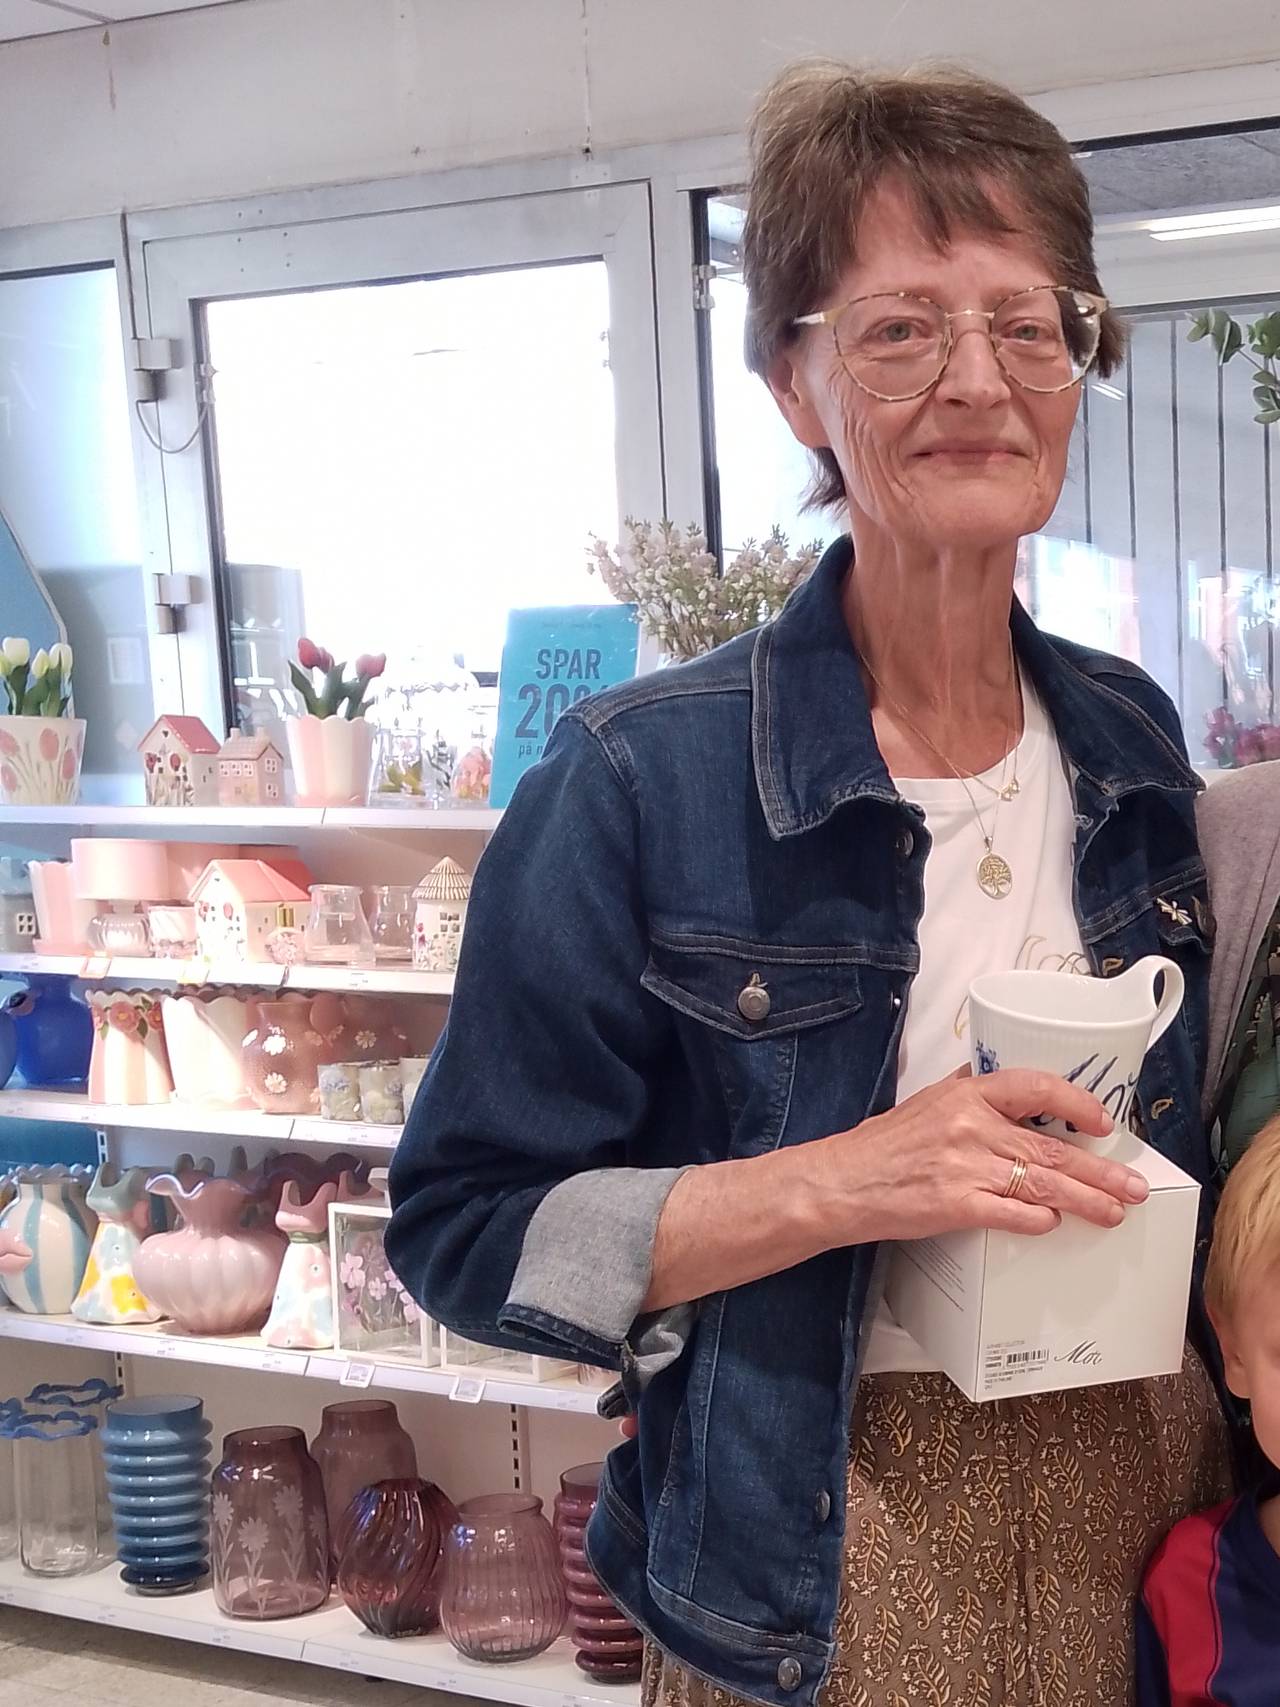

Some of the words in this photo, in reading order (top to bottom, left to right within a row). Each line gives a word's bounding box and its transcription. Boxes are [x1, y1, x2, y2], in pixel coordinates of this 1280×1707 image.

[535, 648, 602, 680] SPAR
[514, 683, 609, 738] 20
[518, 744, 532, 759] på
[1053, 1339, 1103, 1366] Mor
